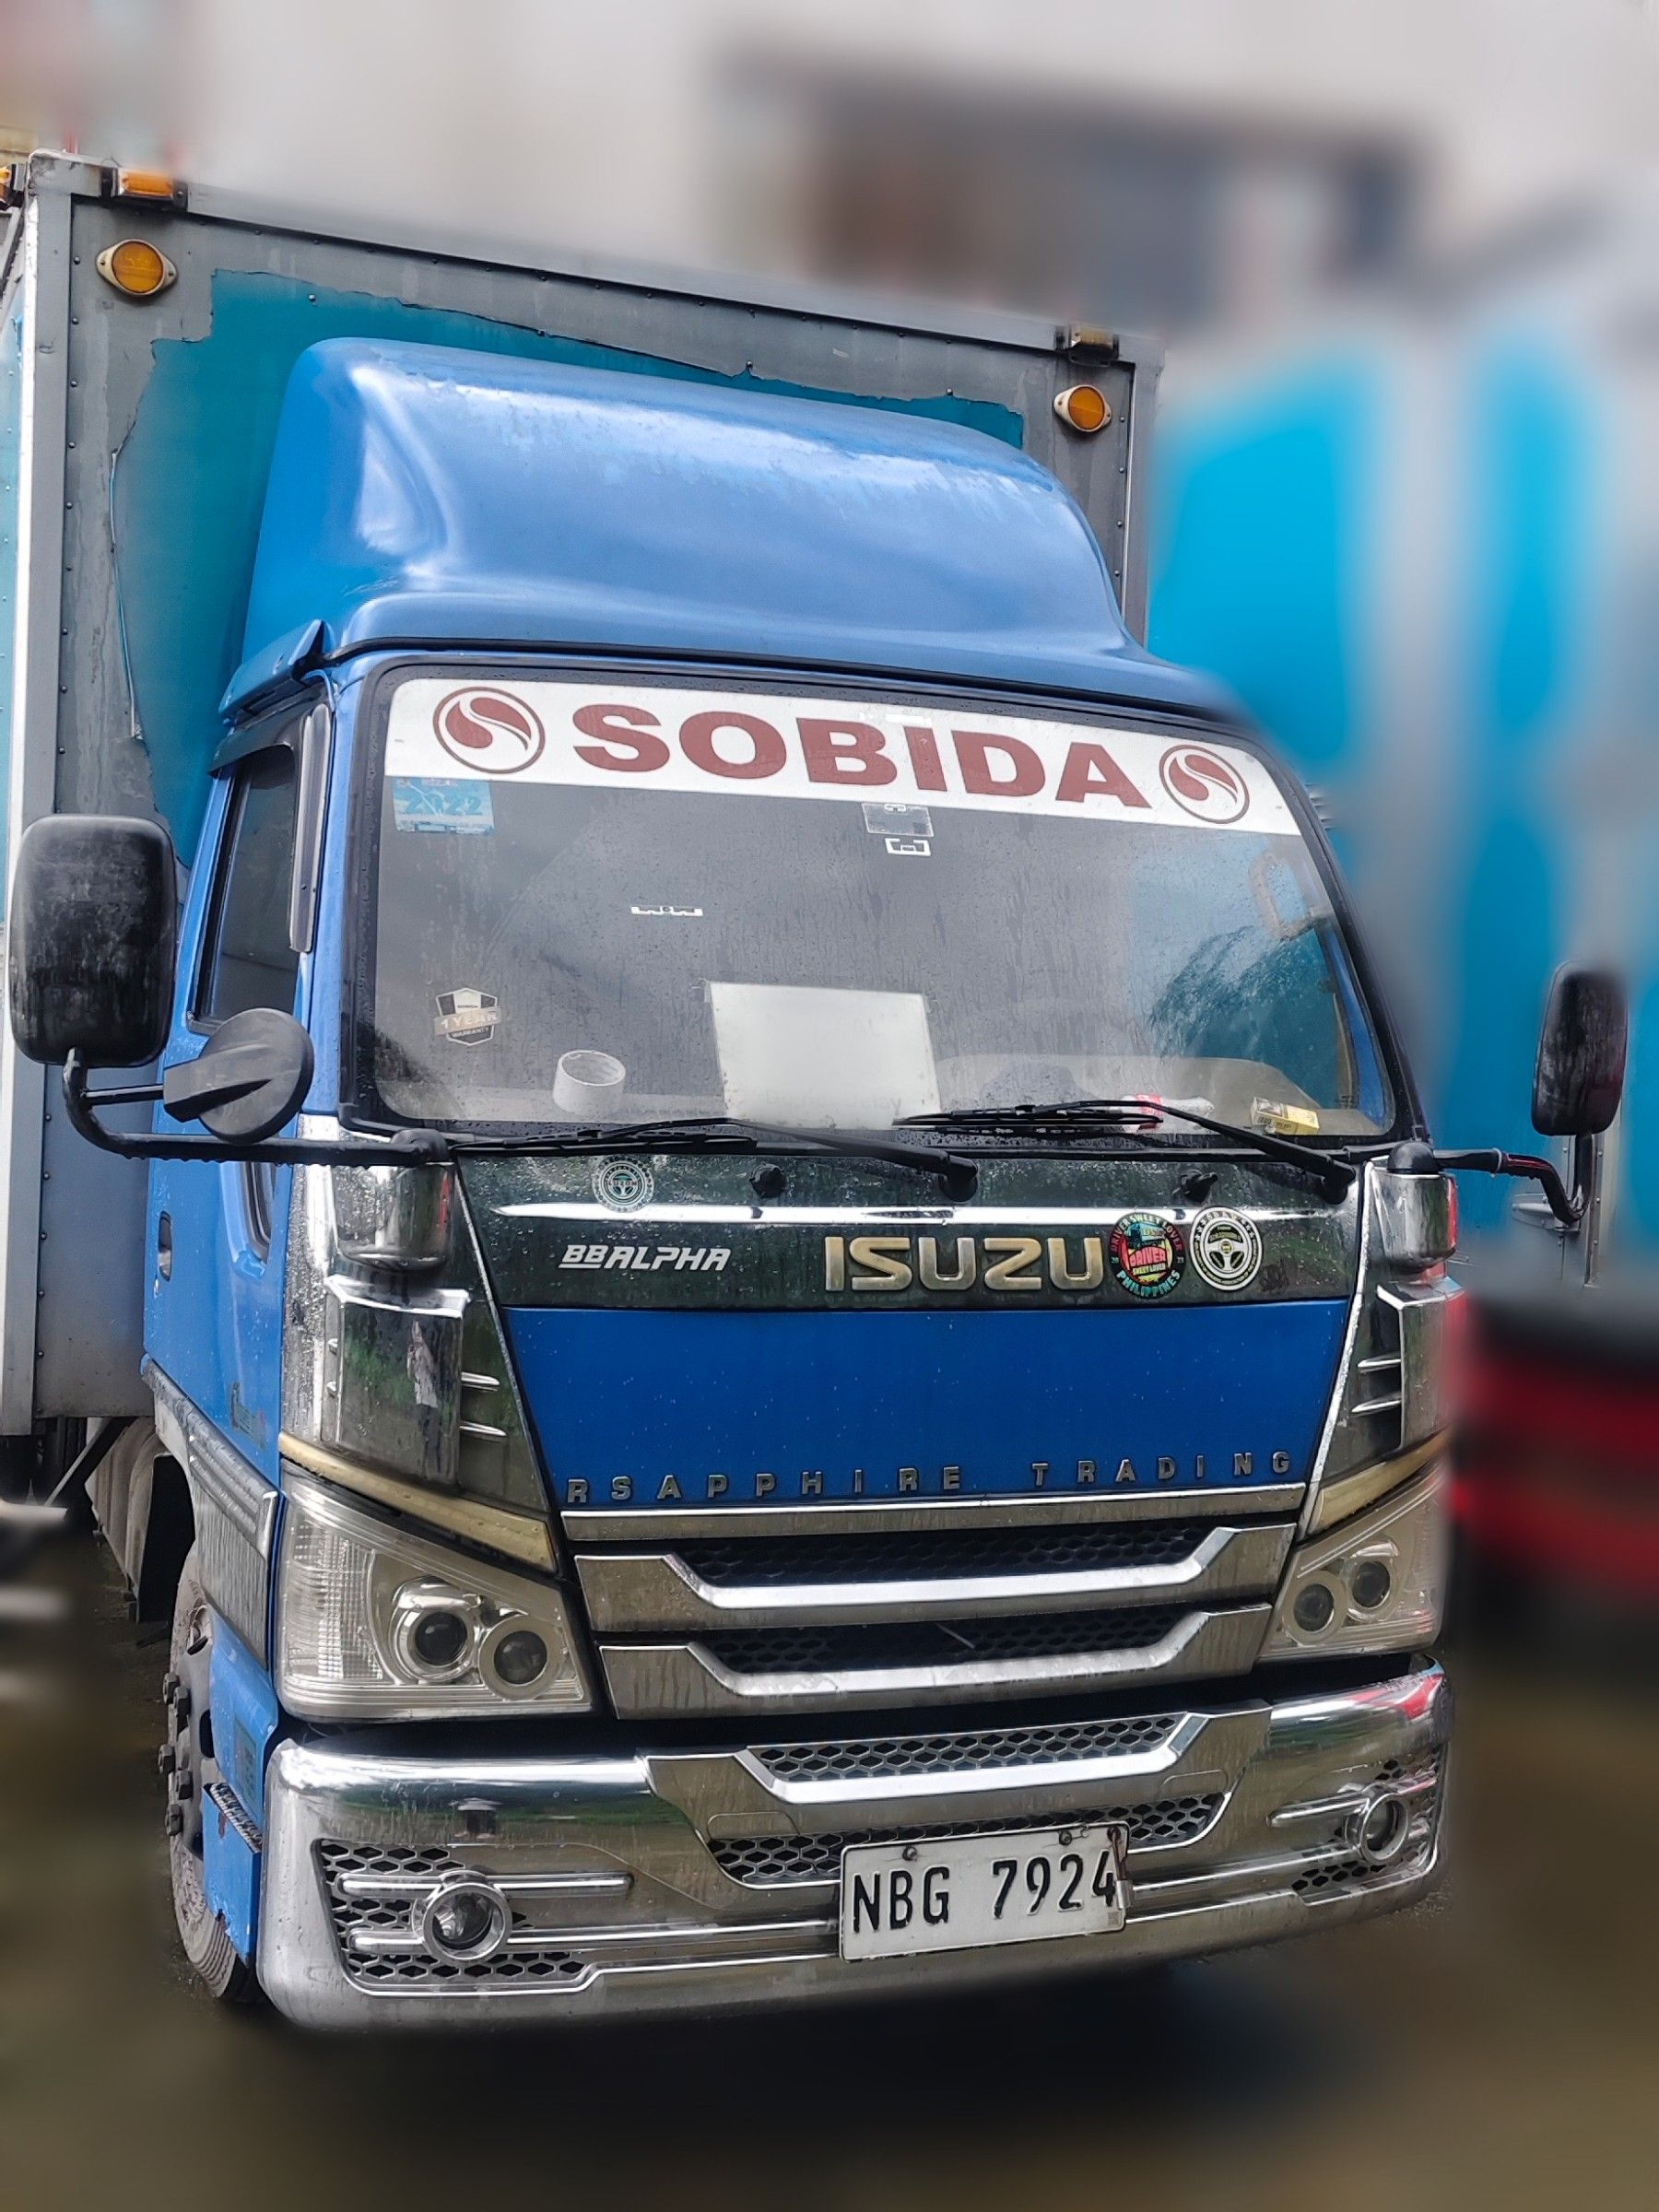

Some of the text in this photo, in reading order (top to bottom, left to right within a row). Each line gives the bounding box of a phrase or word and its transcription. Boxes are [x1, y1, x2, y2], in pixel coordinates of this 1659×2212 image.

[572, 703, 1152, 808] SOBIDA
[1110, 1218, 1131, 1253] DRIVER
[1129, 1213, 1161, 1225] SWEET
[1128, 1246, 1167, 1267] DRIVER
[825, 1236, 1103, 1290] ISUZU
[1116, 1270, 1181, 1297] PHILIPPINES
[567, 1451, 1290, 1504] RSAPPHIRE TRADING
[853, 1850, 1116, 1934] NBG 7924
